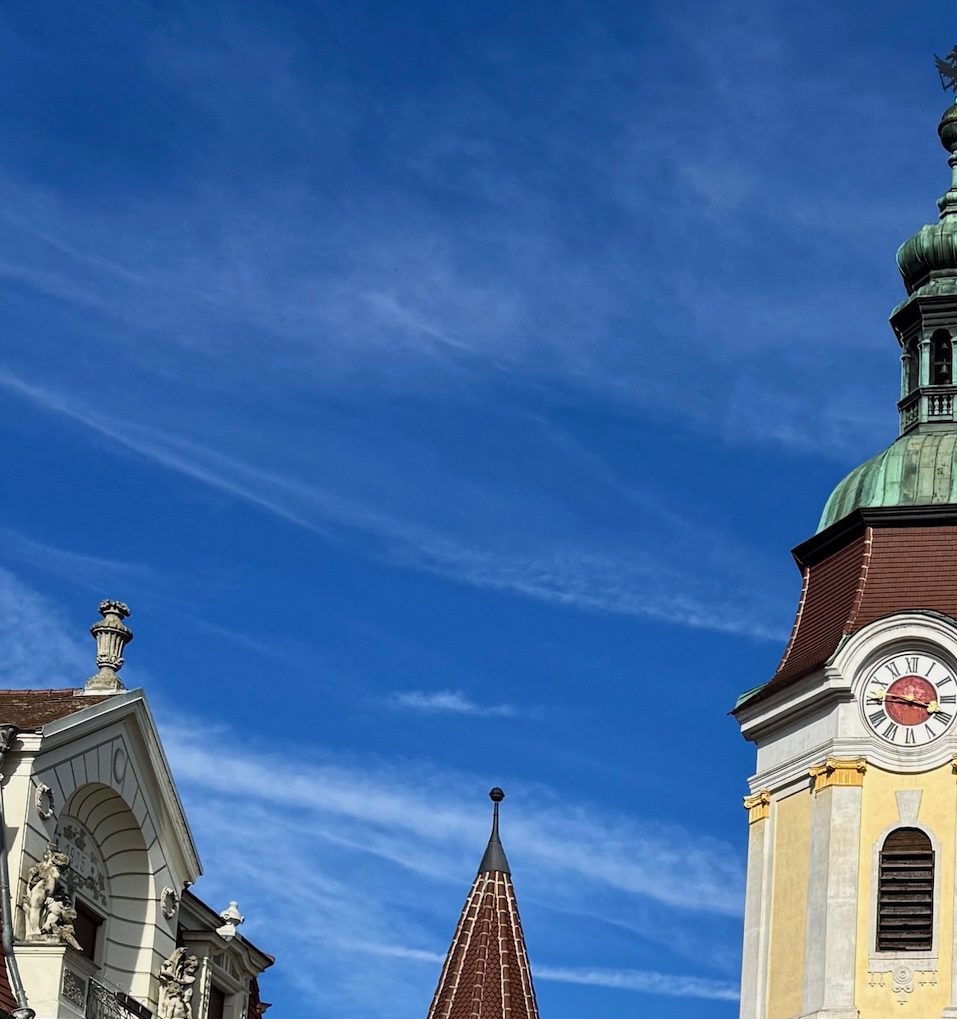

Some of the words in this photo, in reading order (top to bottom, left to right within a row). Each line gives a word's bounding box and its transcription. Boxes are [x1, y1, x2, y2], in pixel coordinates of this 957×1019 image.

[885, 662, 901, 679] XI
[905, 657, 919, 673] XII
[935, 676, 952, 688] II
[940, 695, 957, 704] III
